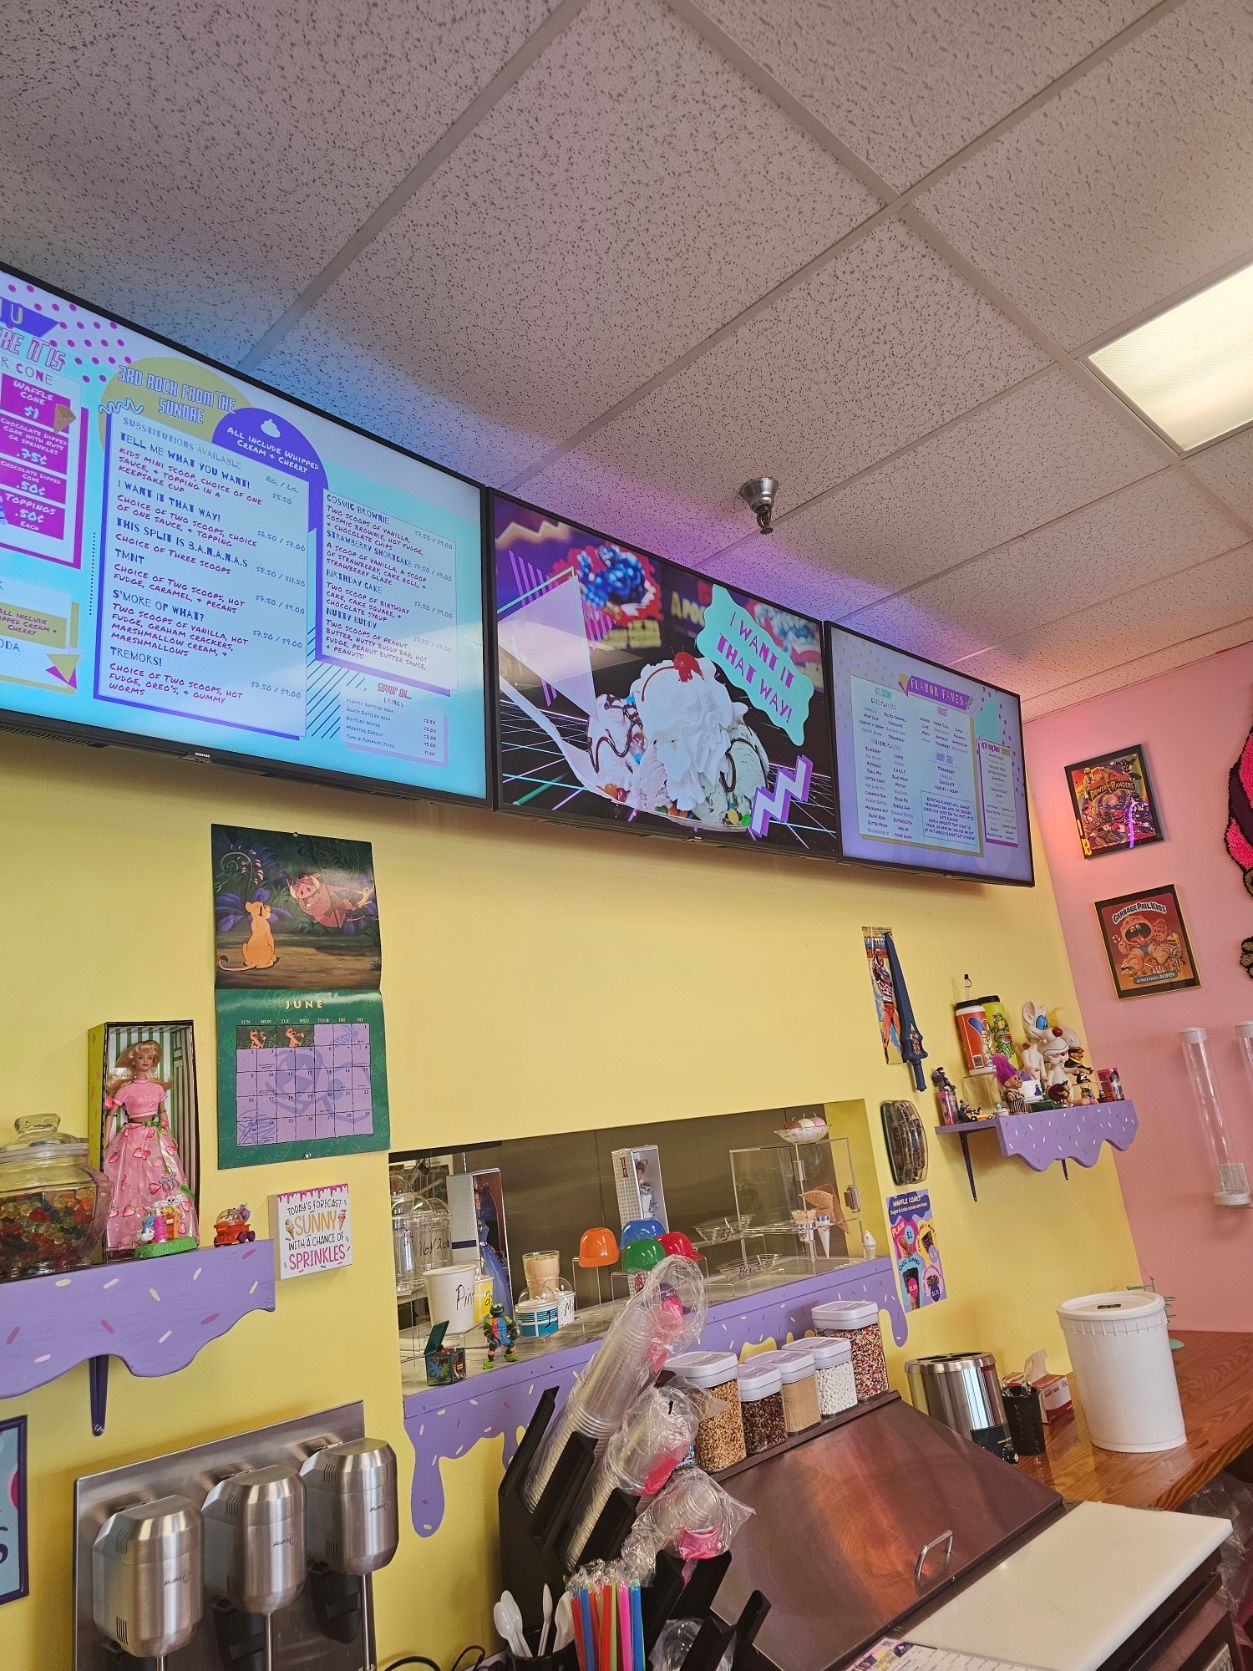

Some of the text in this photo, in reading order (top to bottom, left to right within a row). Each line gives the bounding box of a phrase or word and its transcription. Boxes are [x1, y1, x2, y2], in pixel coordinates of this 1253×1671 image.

[16, 363, 53, 385] CONE
[13, 380, 54, 400] WAFFLE
[20, 391, 45, 405] CONE
[147, 373, 178, 397] ROCK
[181, 384, 214, 407] FROM
[215, 391, 236, 414] THE
[25, 406, 39, 419] $1
[158, 398, 204, 424] SUNDAE
[0, 417, 41, 436] CHOCOLATE
[3, 426, 22, 436] CONE
[21, 439, 59, 455] SPRINKLES
[227, 427, 319, 470] ALL INCLUDE WHIPPED
[237, 439, 308, 474] CREAM CHERRY
[0, 460, 38, 476] CHOCOLATE
[120, 432, 146, 449] TELL
[150, 444, 165, 456] ME
[167, 450, 195, 468] WHAT
[199, 463, 218, 476] YOU
[221, 471, 250, 489] WANT!
[118, 465, 184, 492] KEEPSAKE CUP
[119, 448, 140, 459] KIDS
[144, 456, 164, 468] MINI
[201, 479, 230, 493] CHOICE
[247, 495, 262, 506] ONE
[164, 472, 199, 490] TOPPING
[5, 493, 56, 515] TOPPINGS
[124, 481, 152, 498] WANT
[169, 497, 194, 513] THAT
[326, 494, 390, 525] COSMIC BROWNIE
[326, 505, 370, 527] TWO SCOOPS
[20, 521, 40, 531] EACH
[117, 494, 151, 511] CHOICE
[170, 512, 188, 524] TWO
[229, 533, 257, 547] CHOICE
[133, 510, 150, 520] ONE
[197, 530, 232, 547] TOPPING
[326, 514, 352, 527] COSMIC
[116, 517, 185, 547] THIS SPLIT IS
[334, 525, 372, 543] CHOCOLATE
[115, 533, 231, 575] CHOICE THREE SCOOPS
[115, 548, 145, 565] TMNT
[335, 545, 356, 556] SCOOP
[326, 559, 369, 577] STRAWBERRY
[114, 564, 149, 579] CHOICE
[168, 578, 187, 590] TWO
[228, 598, 246, 607] HOT
[326, 569, 383, 594] BIRTHDAY CAKE
[326, 581, 342, 593] TWO
[113, 589, 204, 622] S'MORE WHAT?
[206, 601, 237, 614] PECANS
[326, 599, 365, 616] CHOCOLATE
[16, 612, 48, 625] INCLUDE
[23, 621, 50, 633] CREAM
[112, 602, 134, 615] TWO
[139, 611, 173, 625] SCOOPS
[231, 636, 249, 645] HOT
[8, 624, 37, 636] CHERRY
[111, 622, 184, 646] MARSHMALLOW
[148, 623, 186, 638] GRAHAM
[111, 632, 189, 656] MARSHMALLOWS
[110, 646, 162, 667] TREMORS!
[740, 620, 779, 671] WANT
[780, 666, 795, 689] IT
[109, 662, 145, 677] CHOICE
[164, 674, 185, 686] TWO
[226, 690, 244, 699] HOT
[717, 633, 792, 724] THAT WAY!
[910, 679, 938, 697] FLAVOR
[109, 683, 146, 696] WORMS
[193, 691, 226, 704] GUMMY
[1113, 904, 1137, 922] GARBAGE
[285, 1000, 323, 1009] JUNE
[287, 1198, 342, 1216] TODAY'S FORECAST
[294, 1210, 337, 1236] SUNNY
[288, 1231, 344, 1251] WITH A CHANCE OF
[288, 1243, 346, 1271] SPRINKLES
